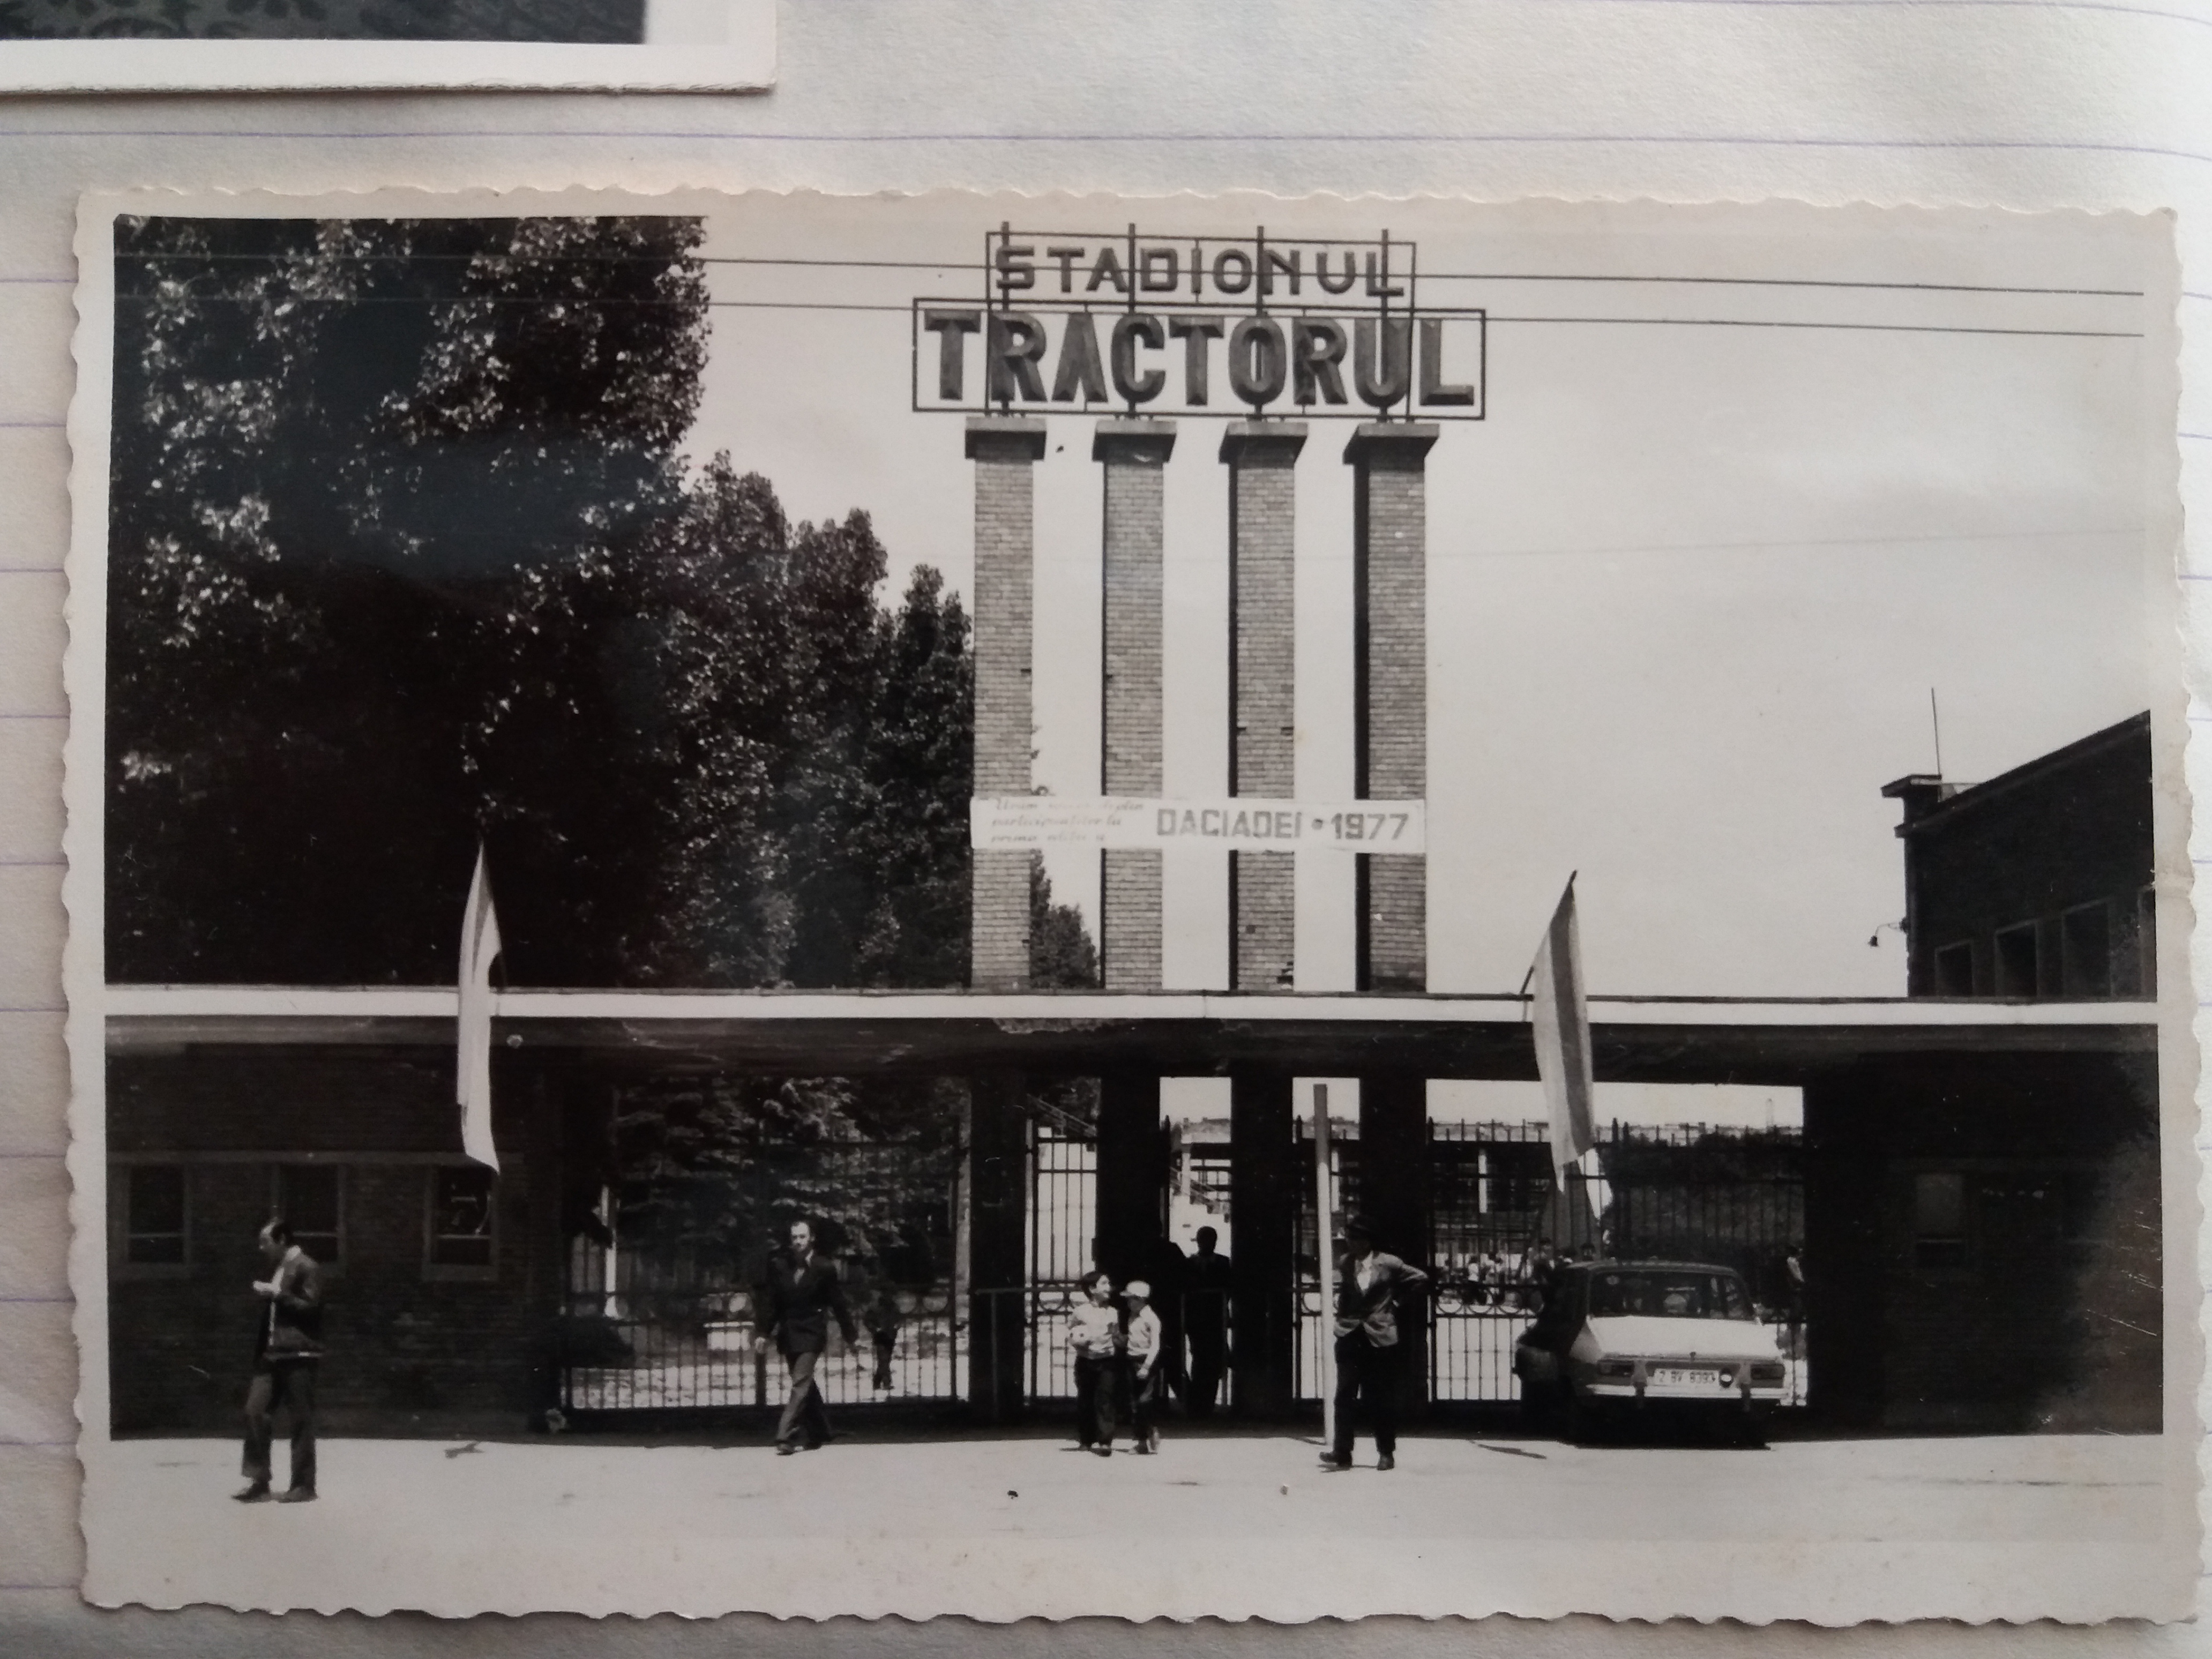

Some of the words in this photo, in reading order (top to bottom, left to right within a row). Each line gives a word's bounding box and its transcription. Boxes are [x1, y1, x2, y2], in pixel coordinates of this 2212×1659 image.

[995, 245, 1404, 297] STADIONUL
[924, 309, 1475, 407] TRACTORUL
[1156, 808, 1302, 839] DACIADEI
[1331, 812, 1409, 840] 1977
